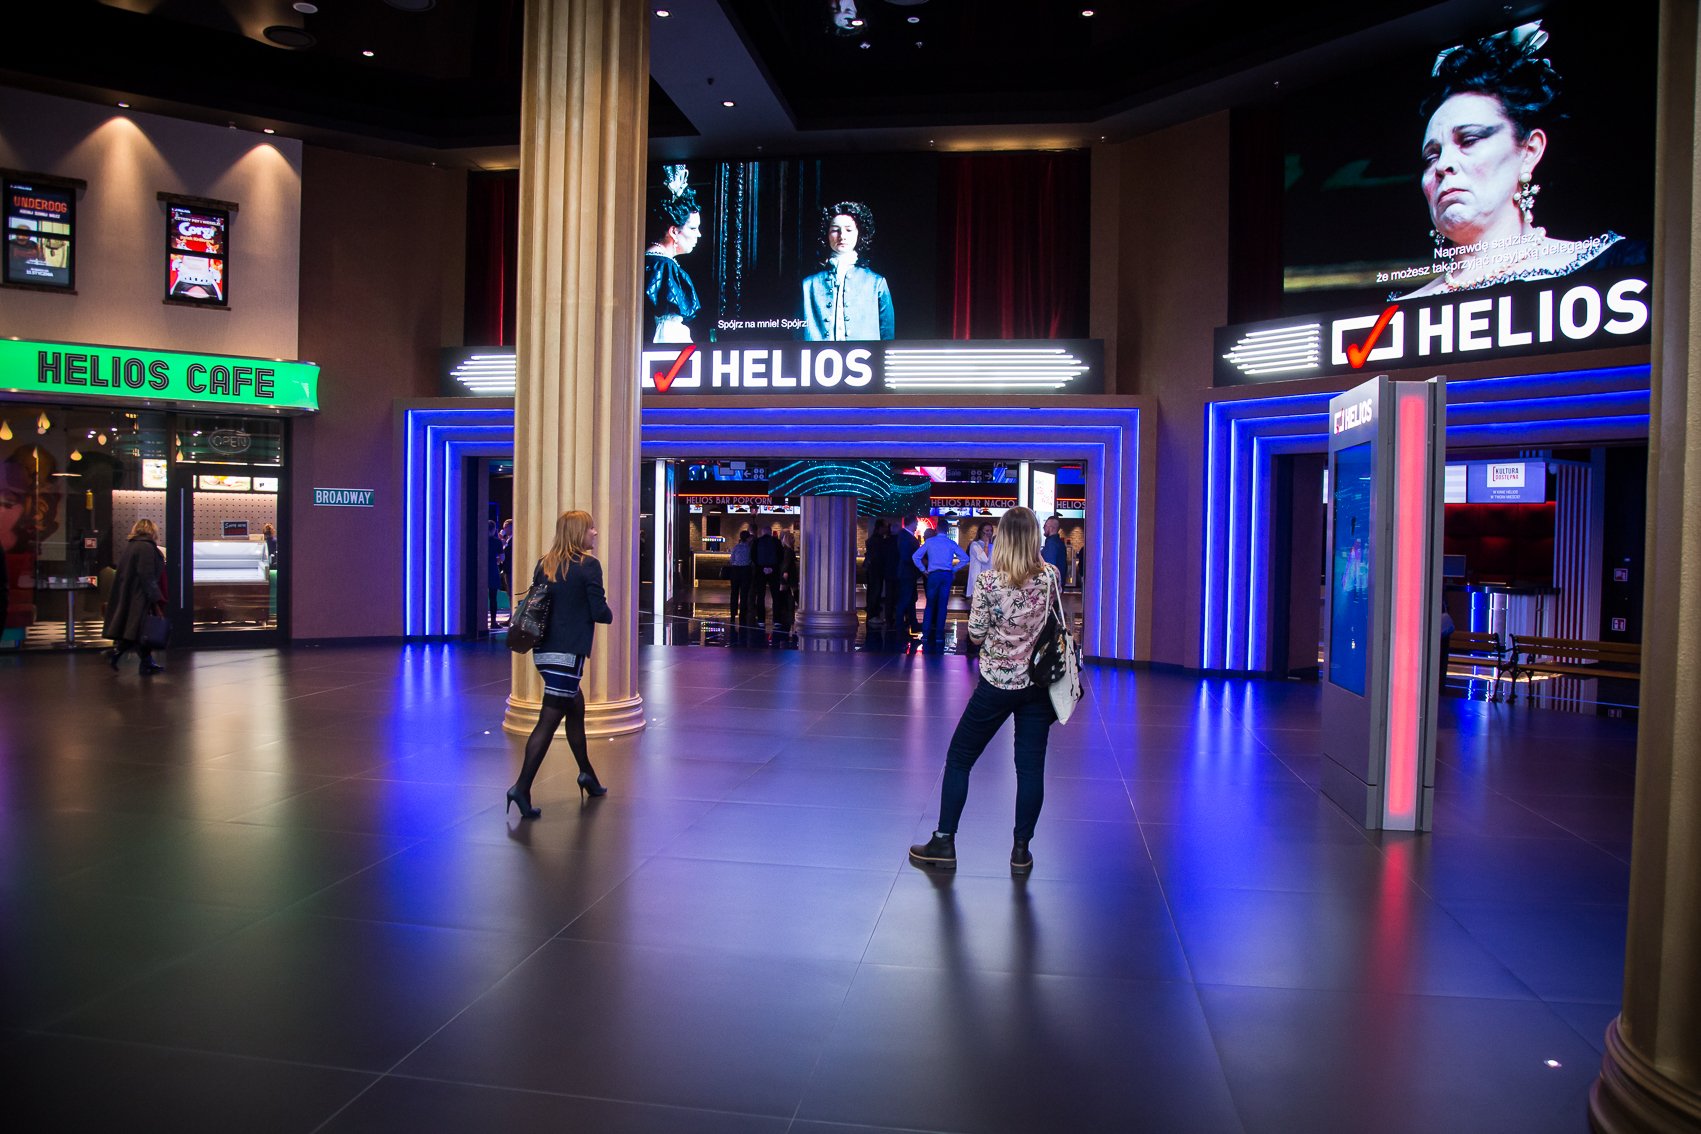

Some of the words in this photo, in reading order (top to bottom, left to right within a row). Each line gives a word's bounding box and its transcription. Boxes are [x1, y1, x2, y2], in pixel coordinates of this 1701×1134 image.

[13, 195, 68, 213] UNDERDOG
[1434, 240, 1489, 259] Naprawdę
[1376, 271, 1389, 283] że
[1391, 266, 1430, 281] możesz
[1432, 261, 1449, 273] tak
[717, 319, 744, 330] Spójrz
[757, 318, 780, 328] mnie!
[1418, 278, 1648, 357] HELIOS
[38, 351, 170, 390] HELIOS
[187, 363, 275, 399] CAFE
[712, 348, 873, 388] HELIOS
[1344, 398, 1373, 431] HELIOS
[212, 435, 249, 448] OPEN
[1495, 467, 1519, 475] KULTURA
[316, 490, 371, 505] BROADWAY
[686, 496, 713, 505] HELIOS
[716, 496, 730, 505] BAR
[733, 496, 773, 505] POPCORN
[931, 498, 962, 507] HELIOS
[965, 499, 981, 507] BAR
[984, 499, 1016, 508] NACHO
[1056, 500, 1086, 509] HELIOS
